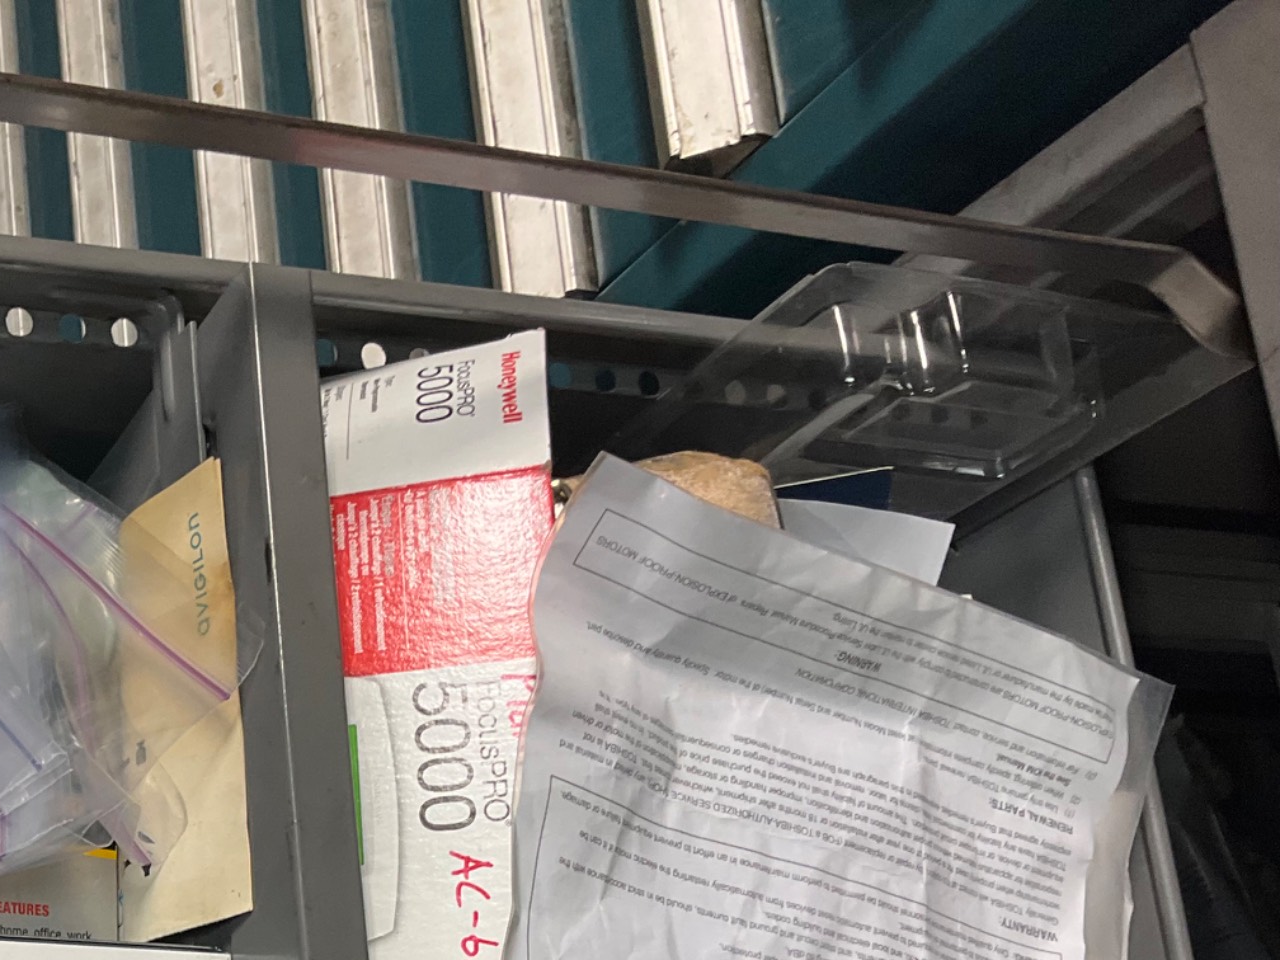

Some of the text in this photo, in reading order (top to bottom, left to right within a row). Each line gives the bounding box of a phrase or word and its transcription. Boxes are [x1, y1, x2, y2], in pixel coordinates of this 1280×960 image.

[414, 363, 454, 424] 5000
[454, 358, 475, 418] FocusPRO
[496, 350, 523, 424] Honeywell
[411, 681, 477, 832] 5000
[475, 682, 510, 823] FocusPRO
